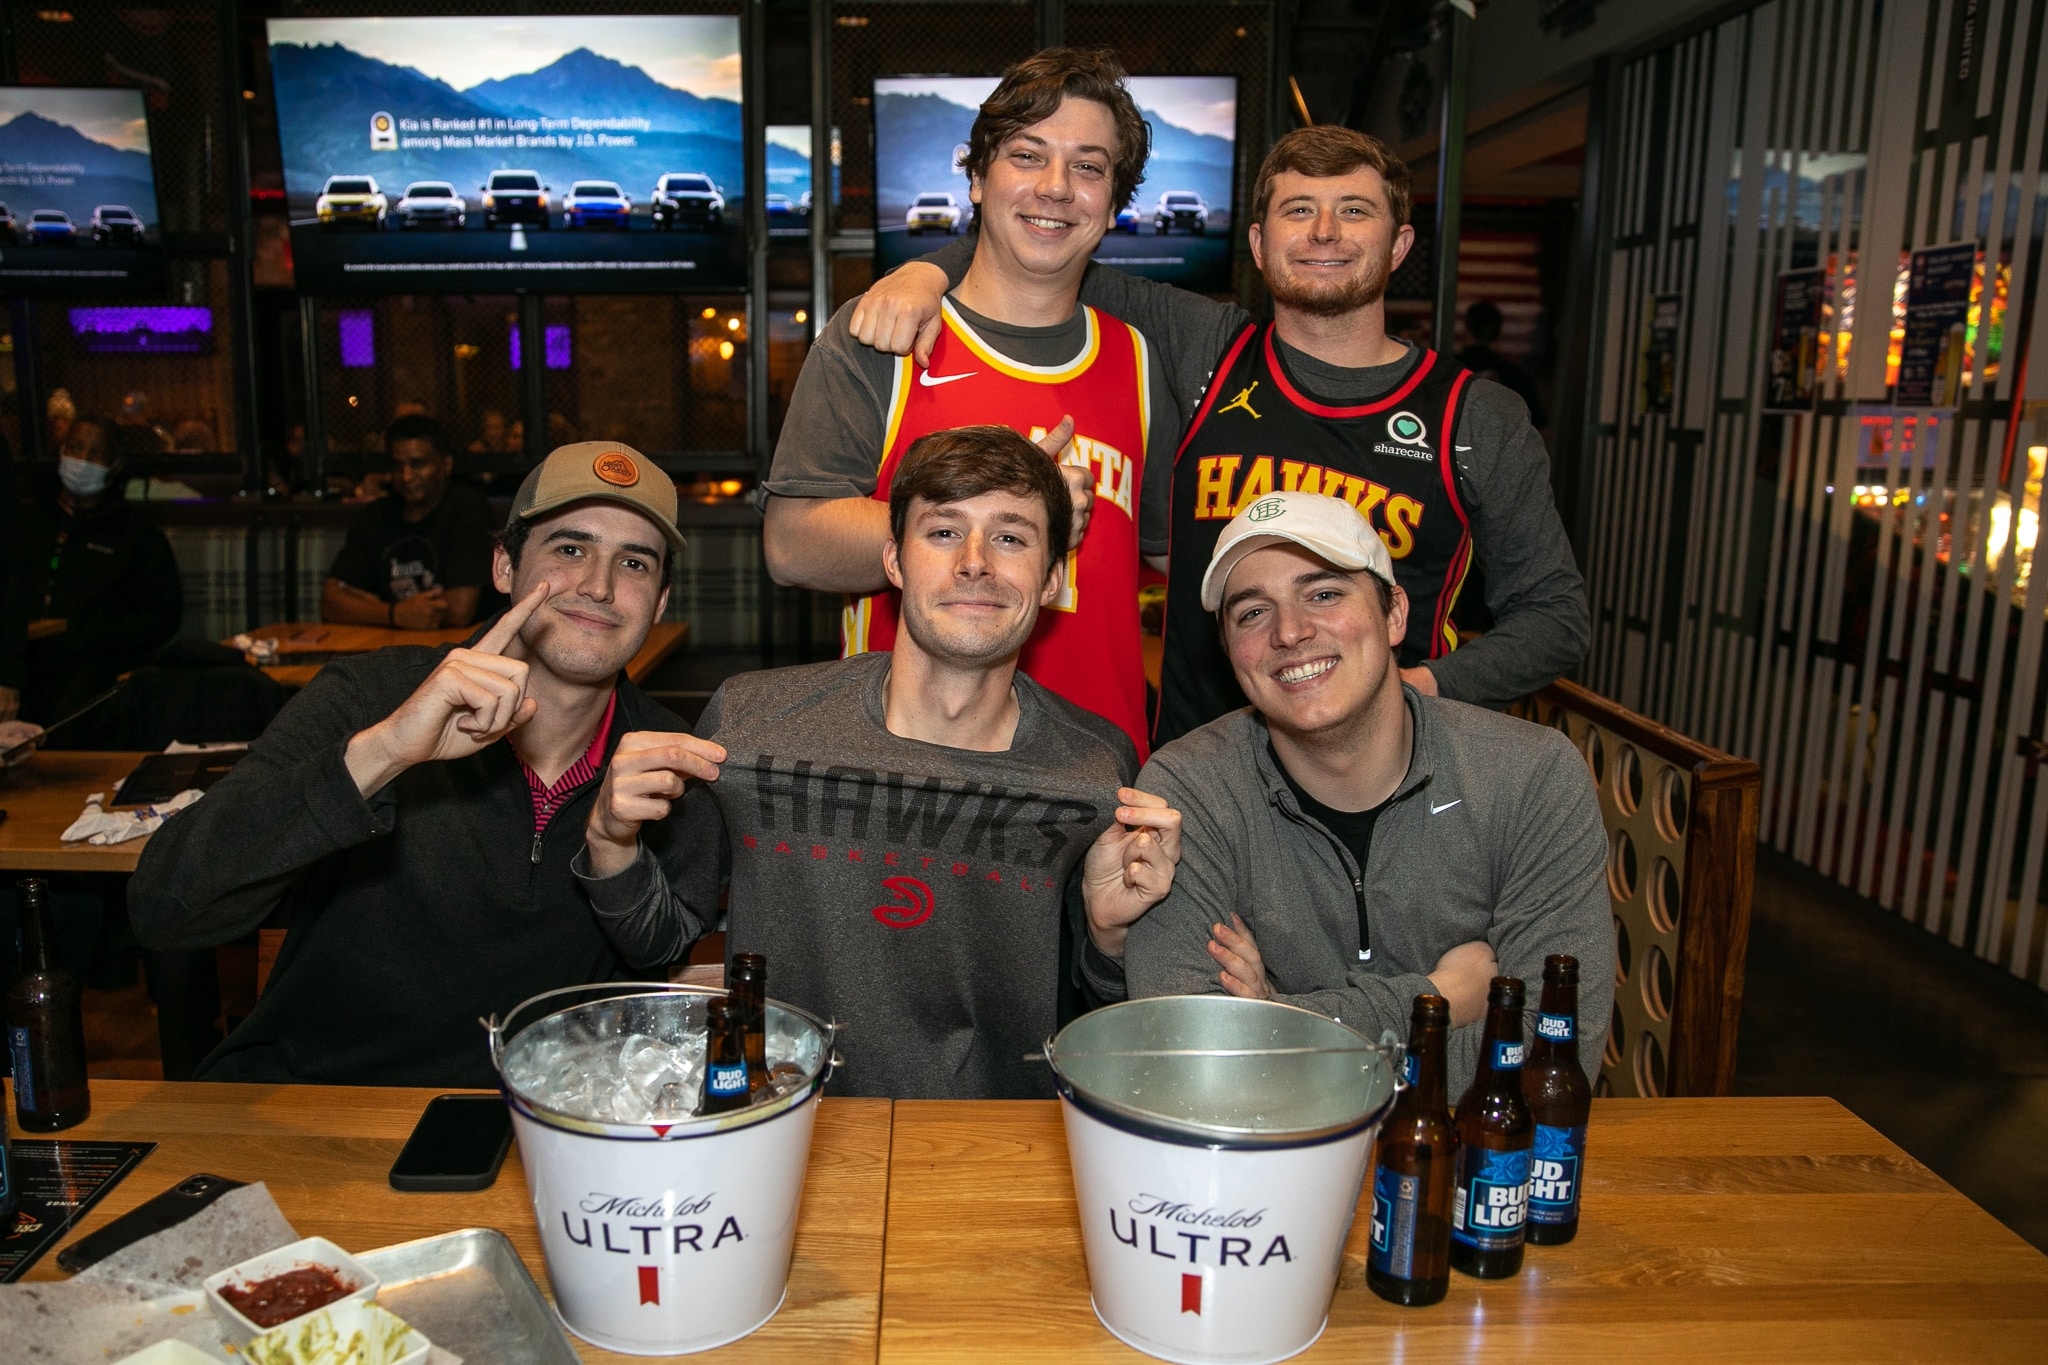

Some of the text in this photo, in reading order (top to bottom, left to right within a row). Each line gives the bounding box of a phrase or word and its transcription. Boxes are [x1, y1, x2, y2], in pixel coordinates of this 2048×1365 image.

[1958, 18, 1977, 80] UNITED
[399, 117, 650, 133] Kia is Ranked #1 in Long-Term Dependability
[401, 138, 441, 150] among
[443, 135, 473, 147] Mass
[474, 135, 514, 147] Market
[516, 134, 557, 147] Brands
[558, 134, 574, 149] by
[575, 134, 597, 147] J.D.
[1374, 443, 1433, 461] sharecare
[755, 754, 1098, 868] HAWKS
[743, 834, 1056, 891] BASKETBALL
[1538, 1023, 1570, 1037] LIGHT
[1542, 1017, 1566, 1029] BUD
[1506, 1045, 1523, 1056] BU
[713, 1077, 747, 1090] LIGHT
[717, 1070, 742, 1081] BUD
[1531, 1159, 1563, 1180] UD
[579, 1192, 717, 1218] Michlob
[1128, 1193, 1269, 1229] Michelob
[1475, 1202, 1528, 1227] LIGH
[562, 1210, 744, 1256] ULTRA
[1110, 1207, 1292, 1267] ULTRA
